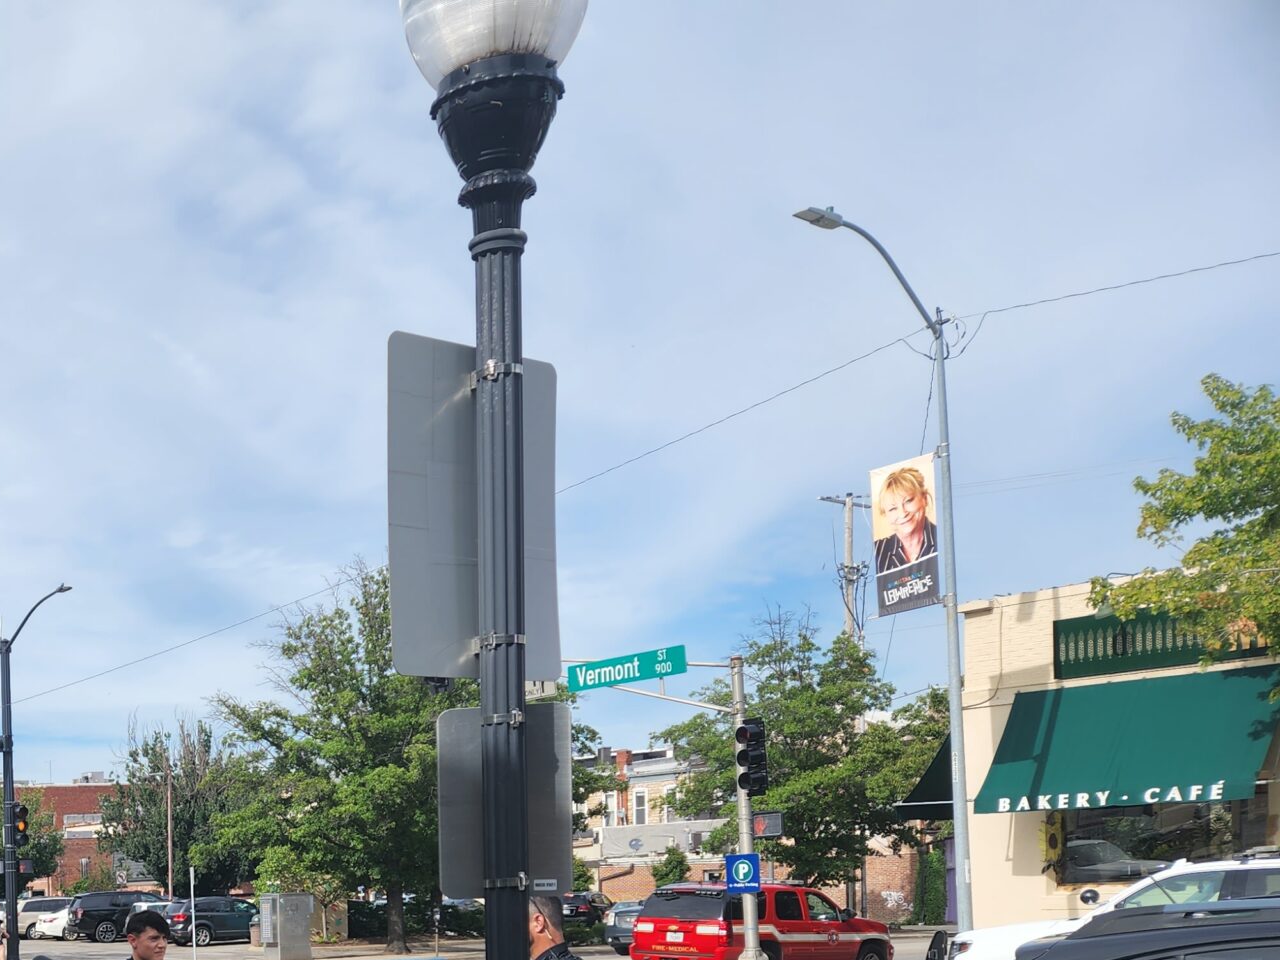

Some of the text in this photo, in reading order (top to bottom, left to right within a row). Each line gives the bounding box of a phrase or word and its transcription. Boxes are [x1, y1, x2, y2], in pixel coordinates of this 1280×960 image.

[883, 574, 933, 605] LAWRENCE
[657, 649, 667, 661] ST
[576, 656, 640, 688] Vermont
[654, 661, 672, 674] 900
[998, 779, 1226, 813] BAKERY CAFÉ
[738, 863, 749, 880] P
